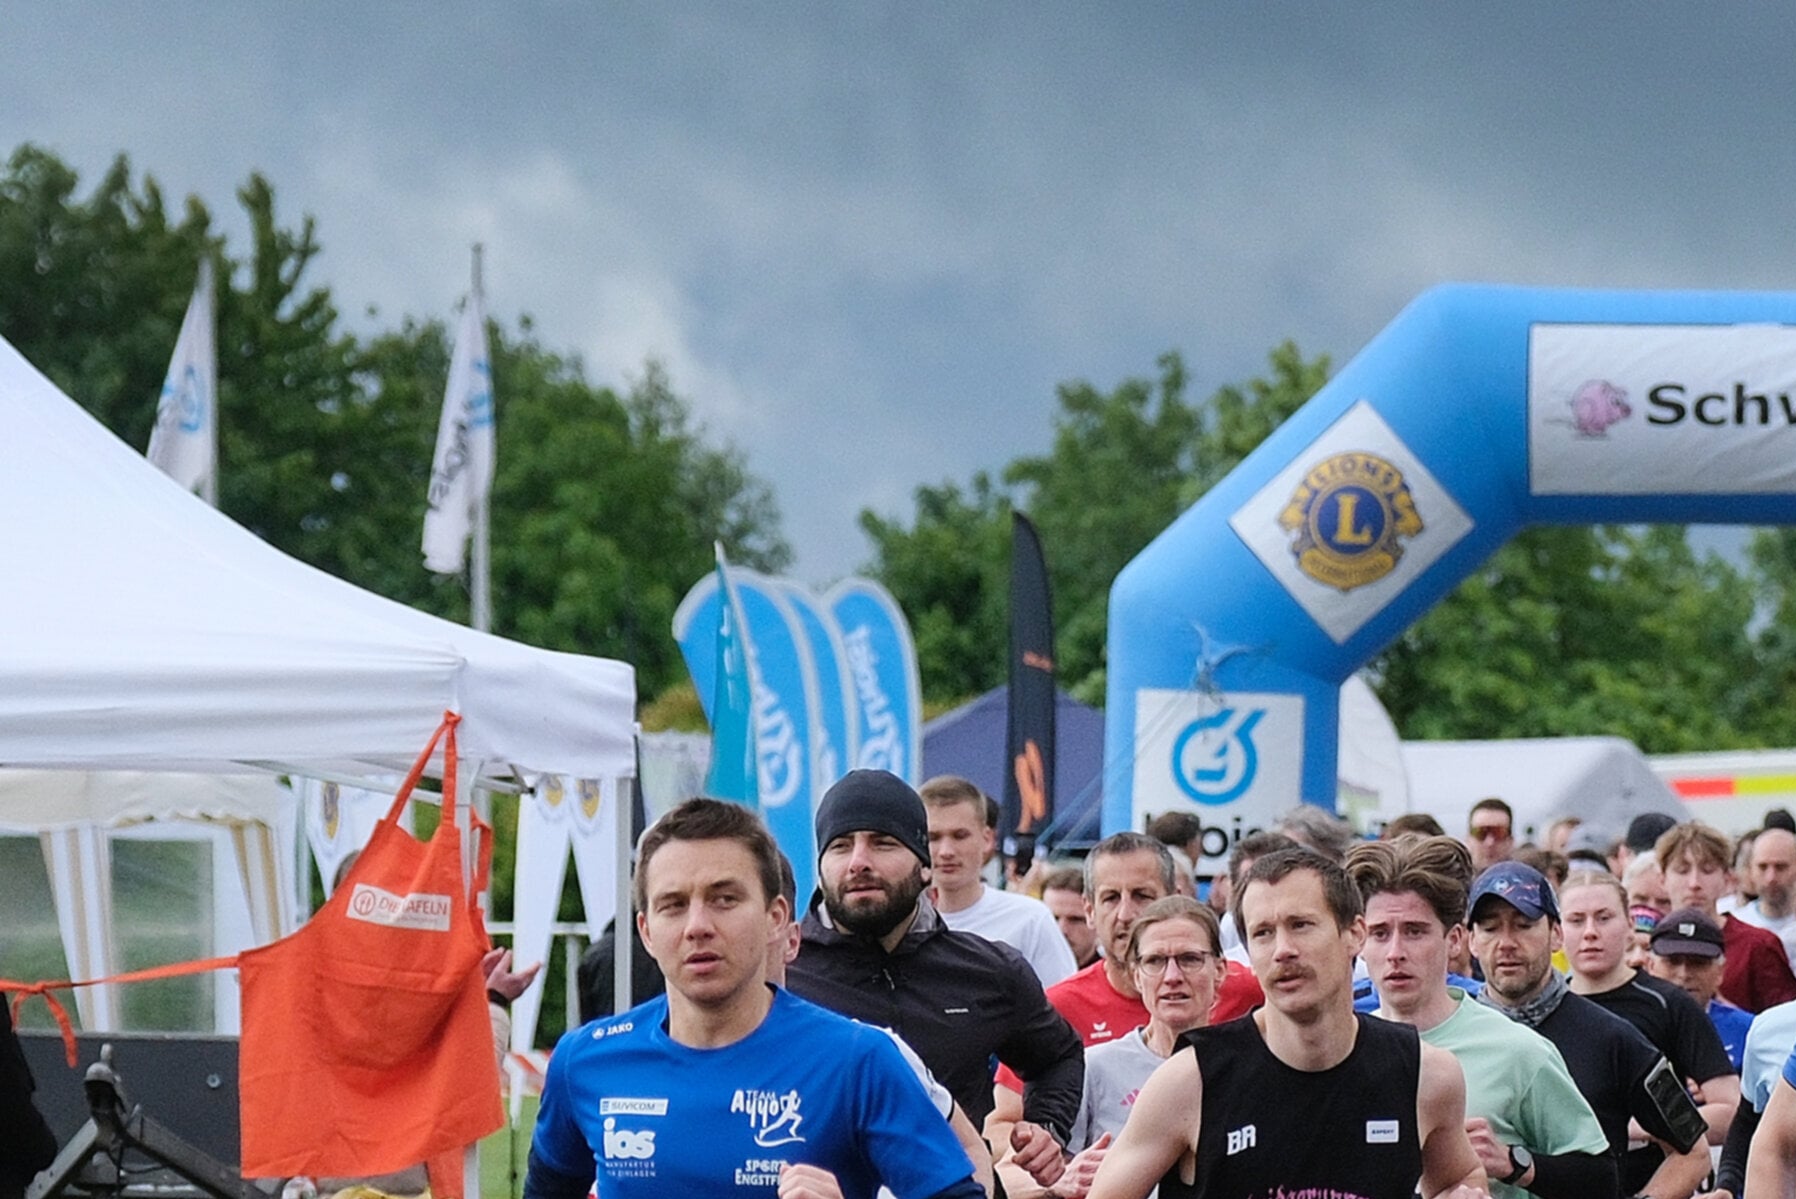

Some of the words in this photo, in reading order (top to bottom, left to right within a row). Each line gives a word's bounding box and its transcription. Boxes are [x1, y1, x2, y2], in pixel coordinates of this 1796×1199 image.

[1334, 493, 1373, 544] L
[606, 1022, 634, 1036] JAKO
[746, 1090, 776, 1100] TEAM
[603, 1116, 656, 1159] ios
